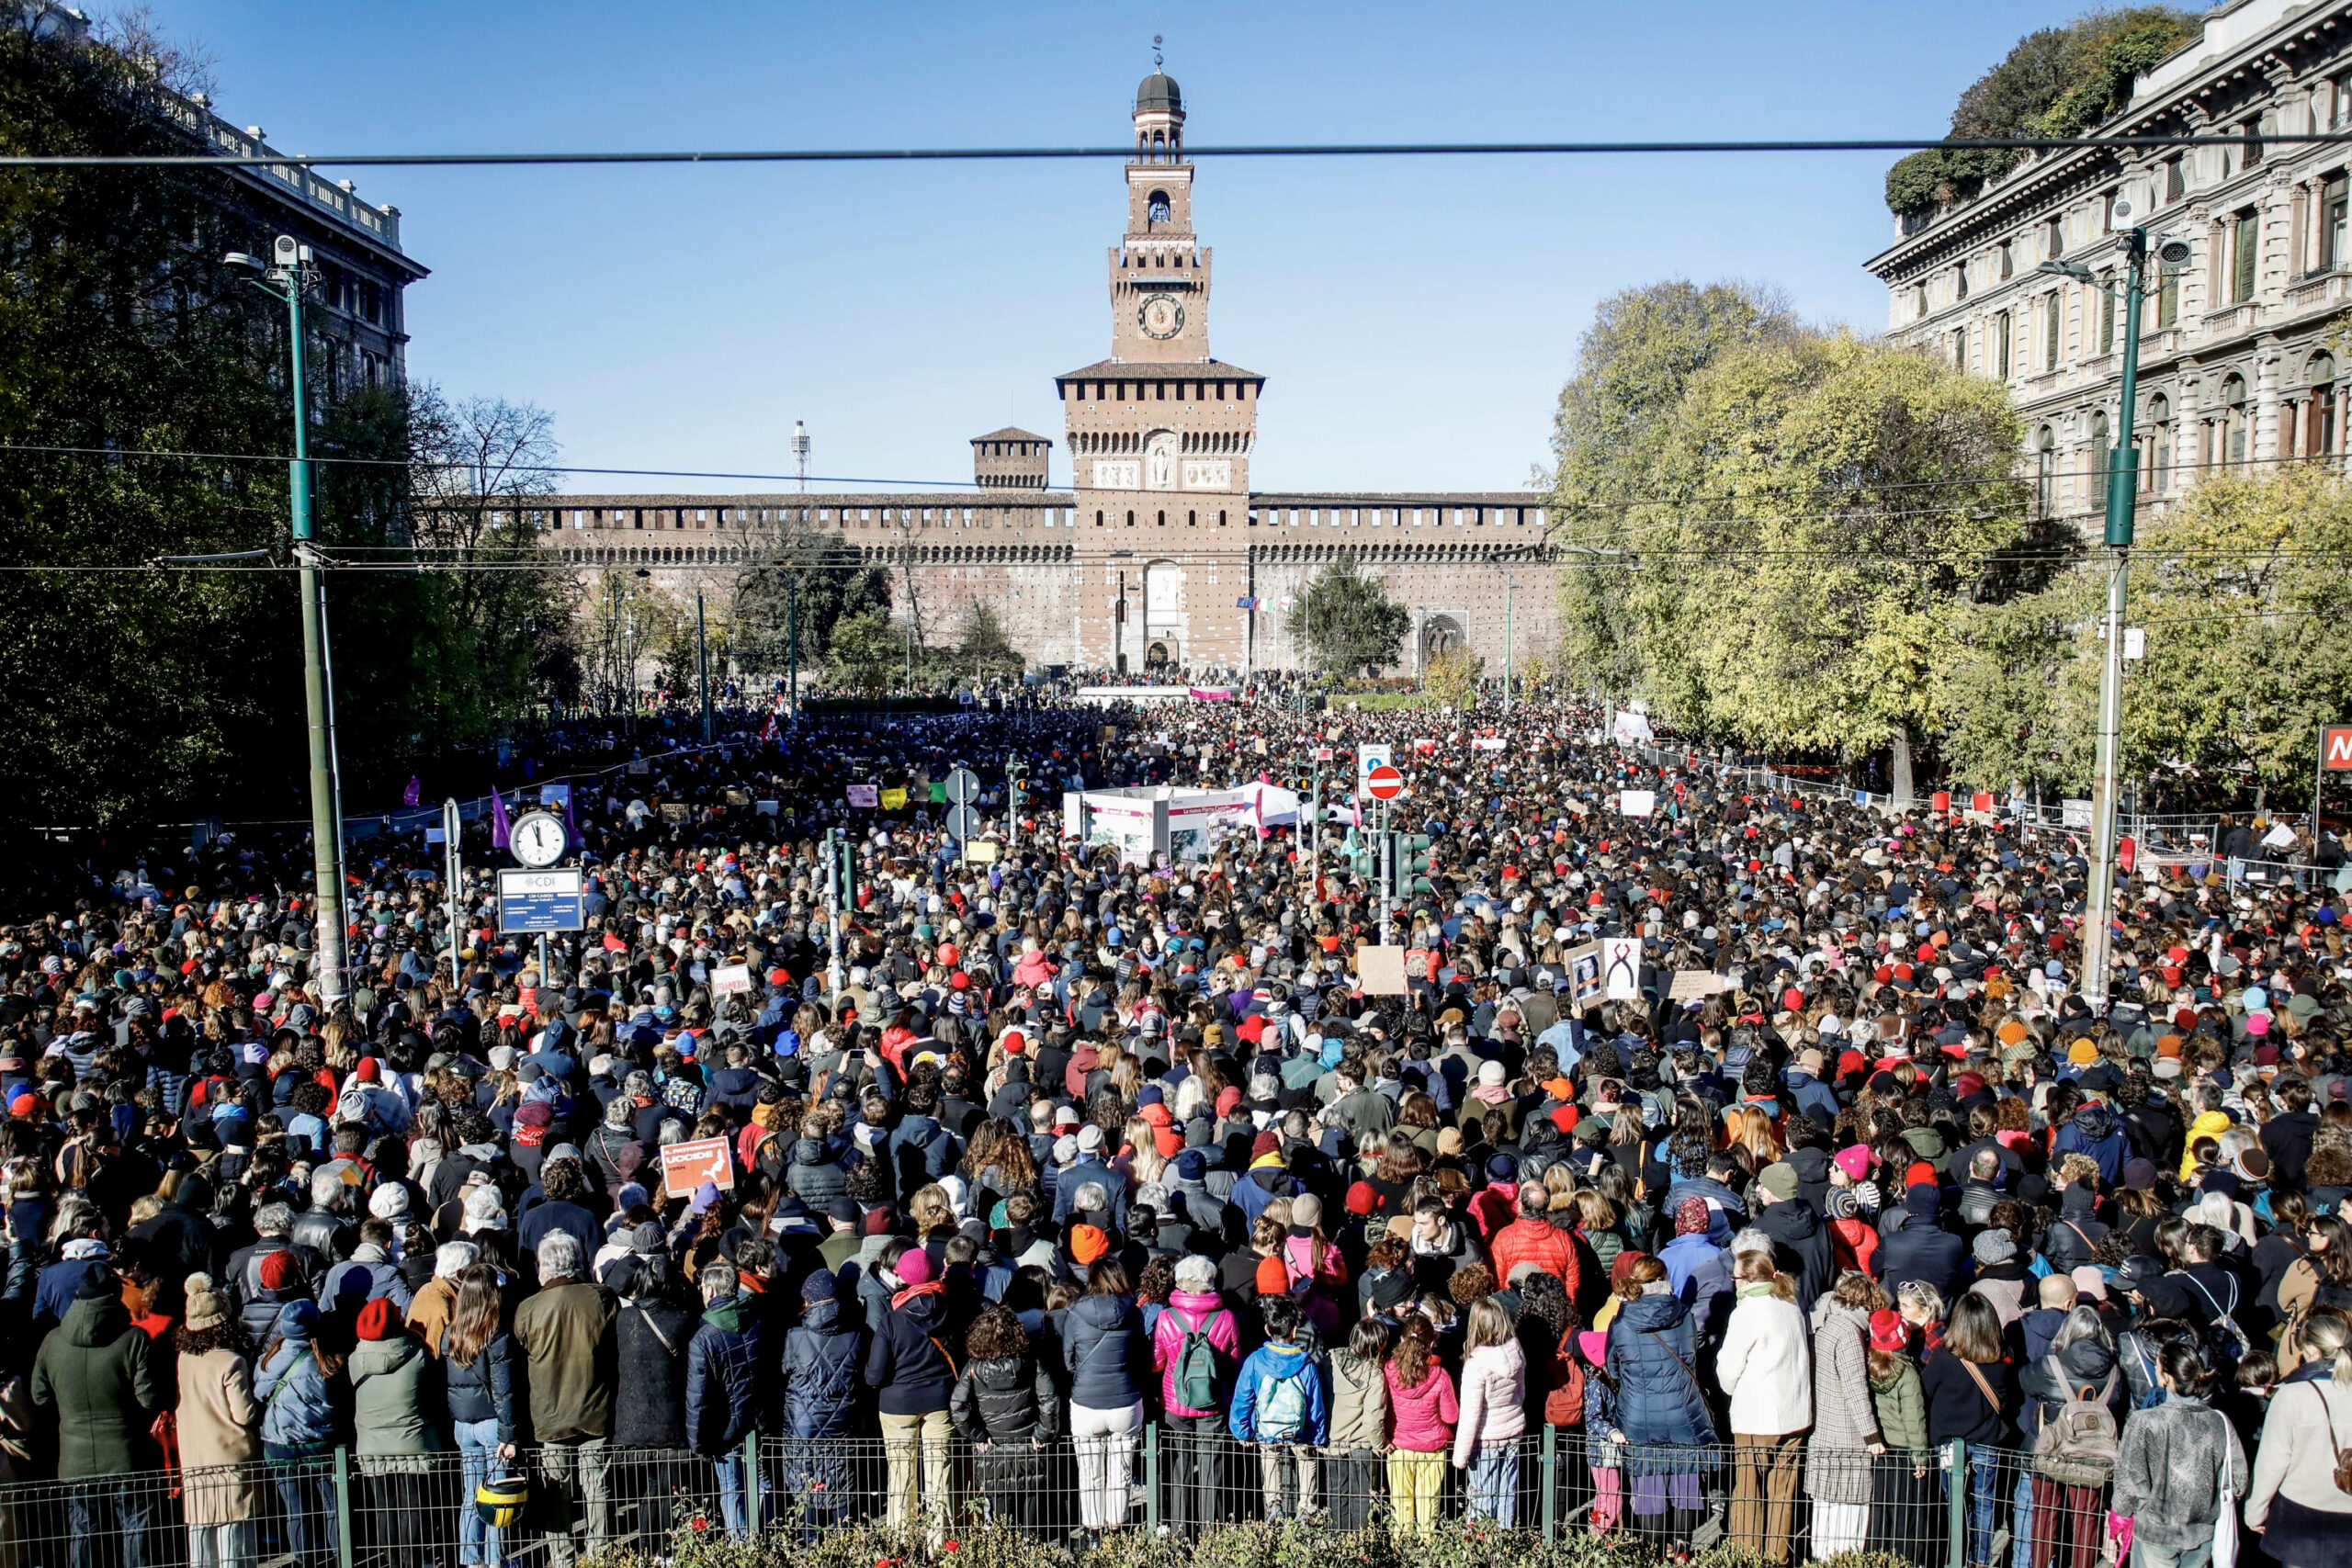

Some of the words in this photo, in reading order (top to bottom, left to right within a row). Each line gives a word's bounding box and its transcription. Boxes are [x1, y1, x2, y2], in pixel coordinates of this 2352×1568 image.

[2328, 735, 2352, 761] M
[535, 876, 555, 886] CDI
[673, 1142, 724, 1154] PATRIARCATO
[665, 1150, 713, 1163] UCCIDE
